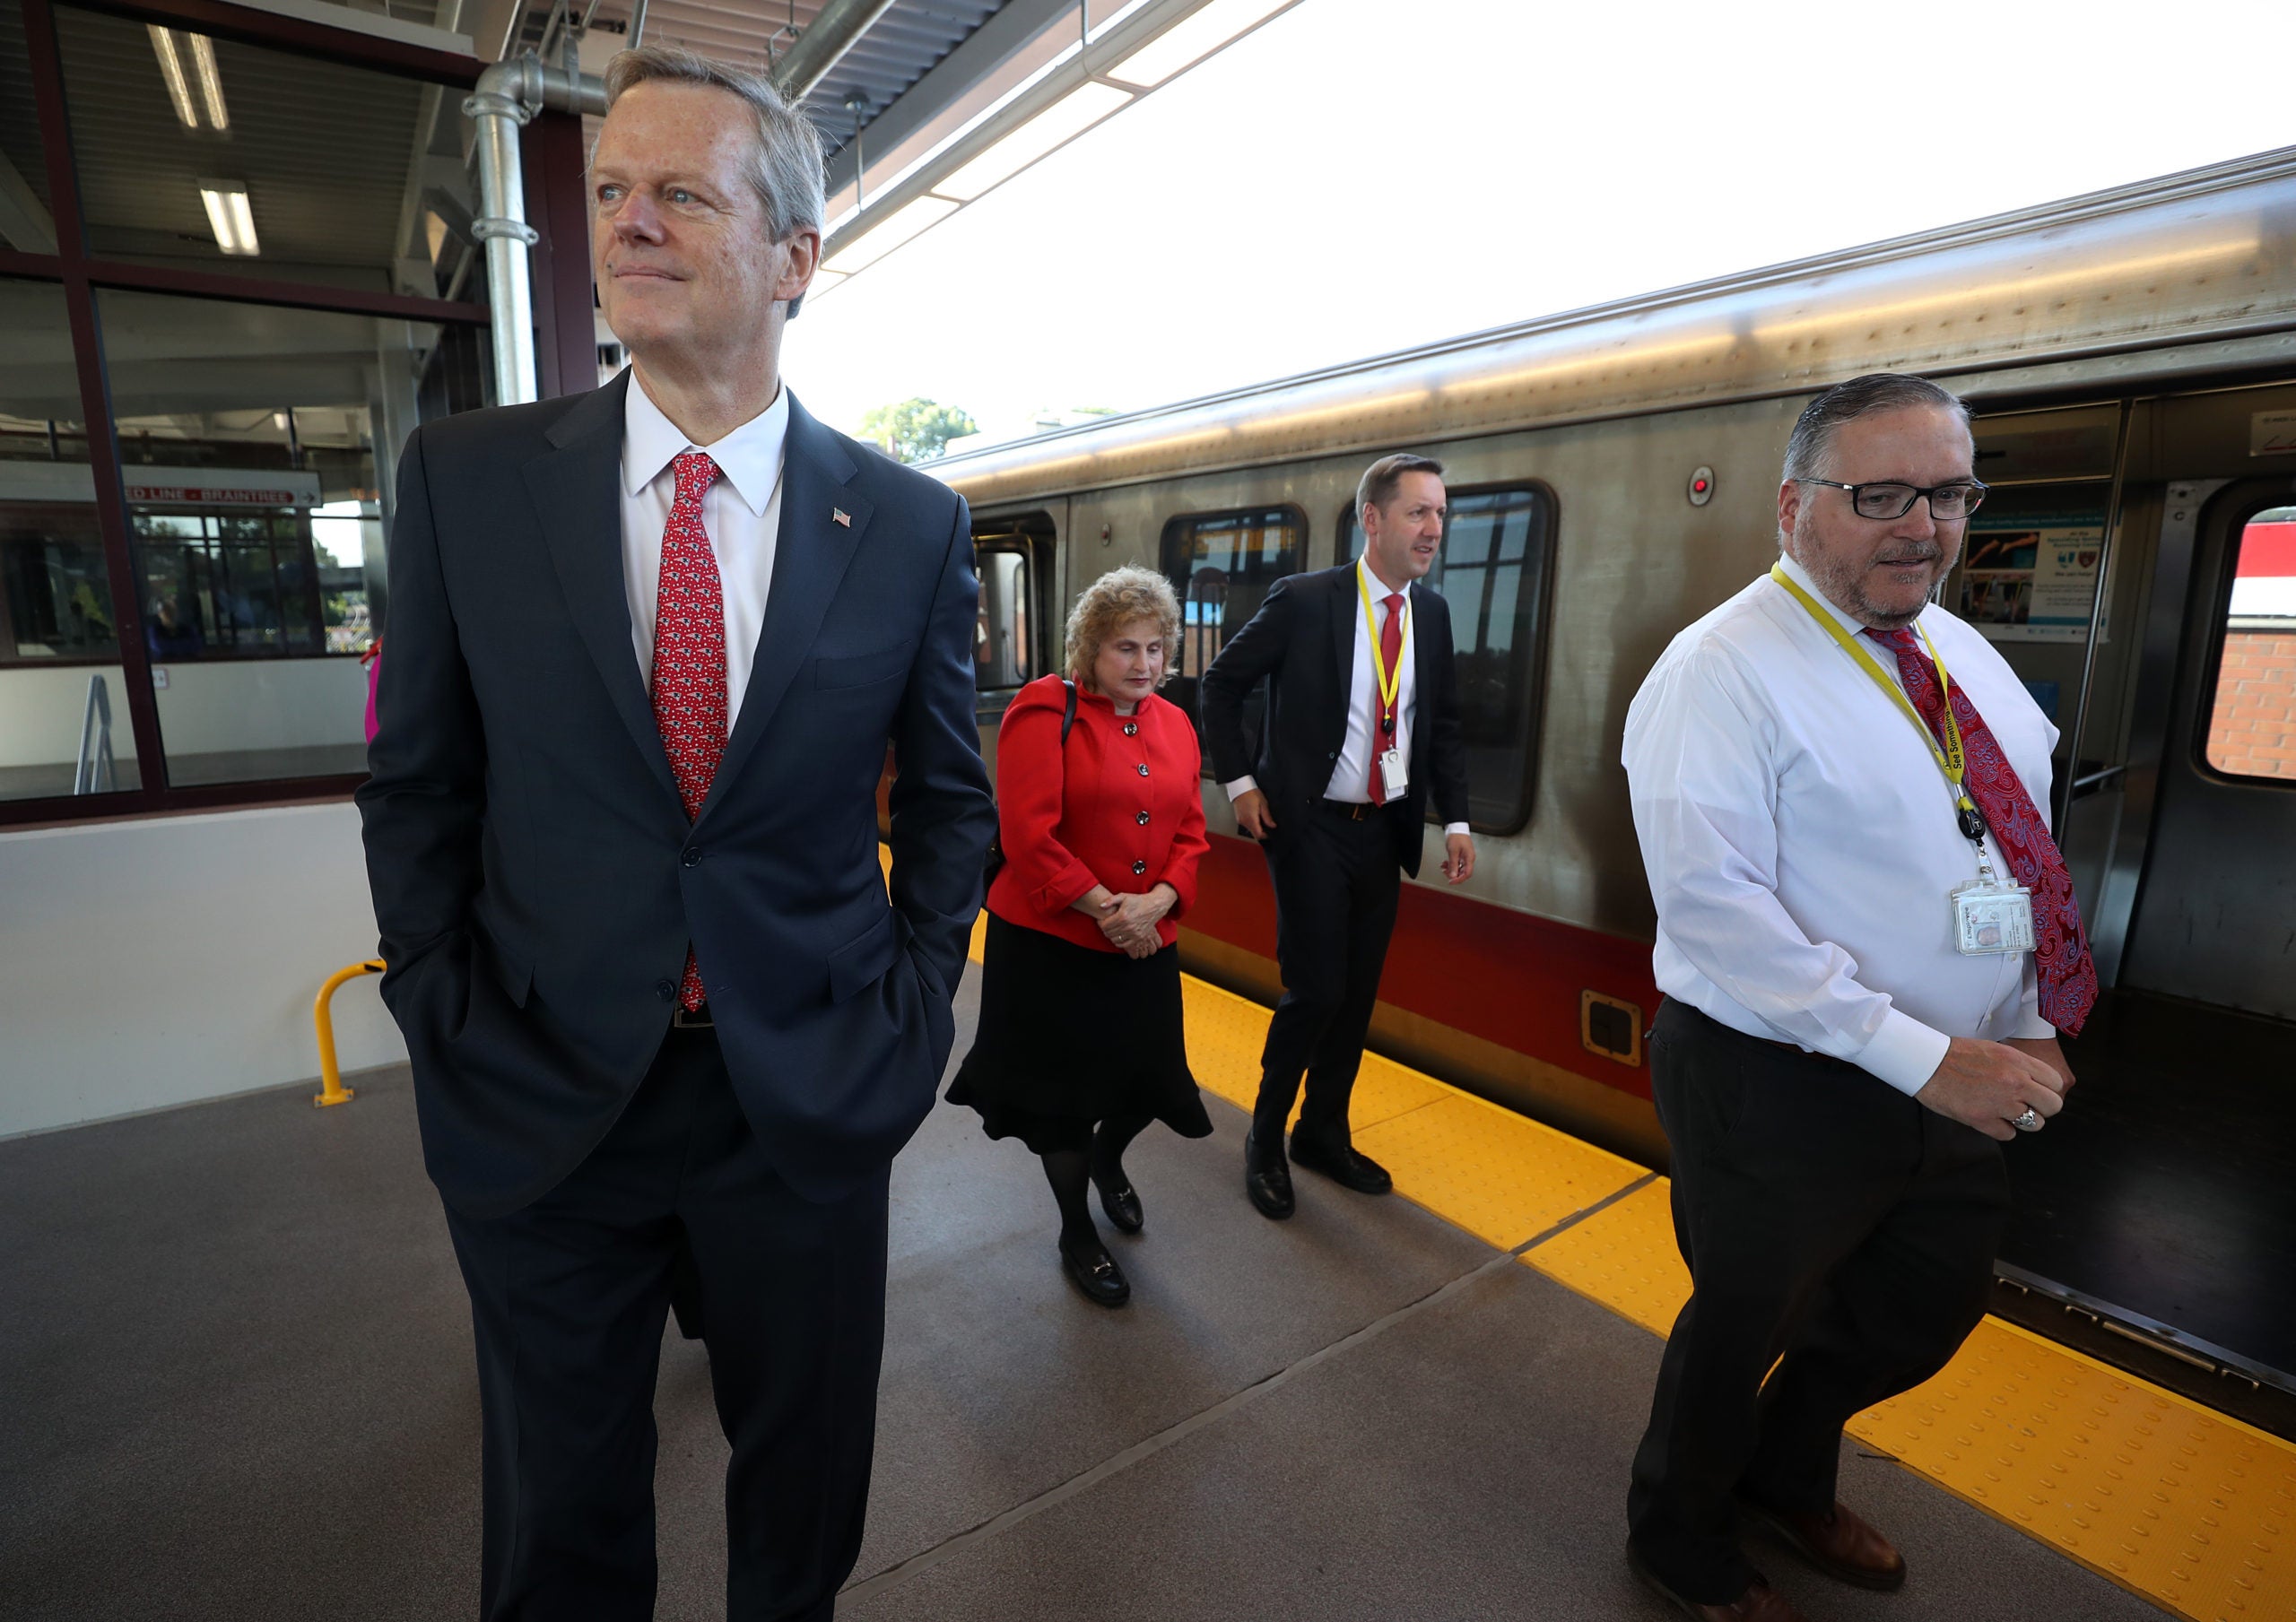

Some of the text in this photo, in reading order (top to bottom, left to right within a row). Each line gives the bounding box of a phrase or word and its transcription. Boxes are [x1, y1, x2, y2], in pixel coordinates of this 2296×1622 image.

[124, 487, 144, 500] ED
[150, 489, 183, 501] LINE
[200, 490, 288, 504] BRAINTREE
[1952, 754, 1962, 769] See
